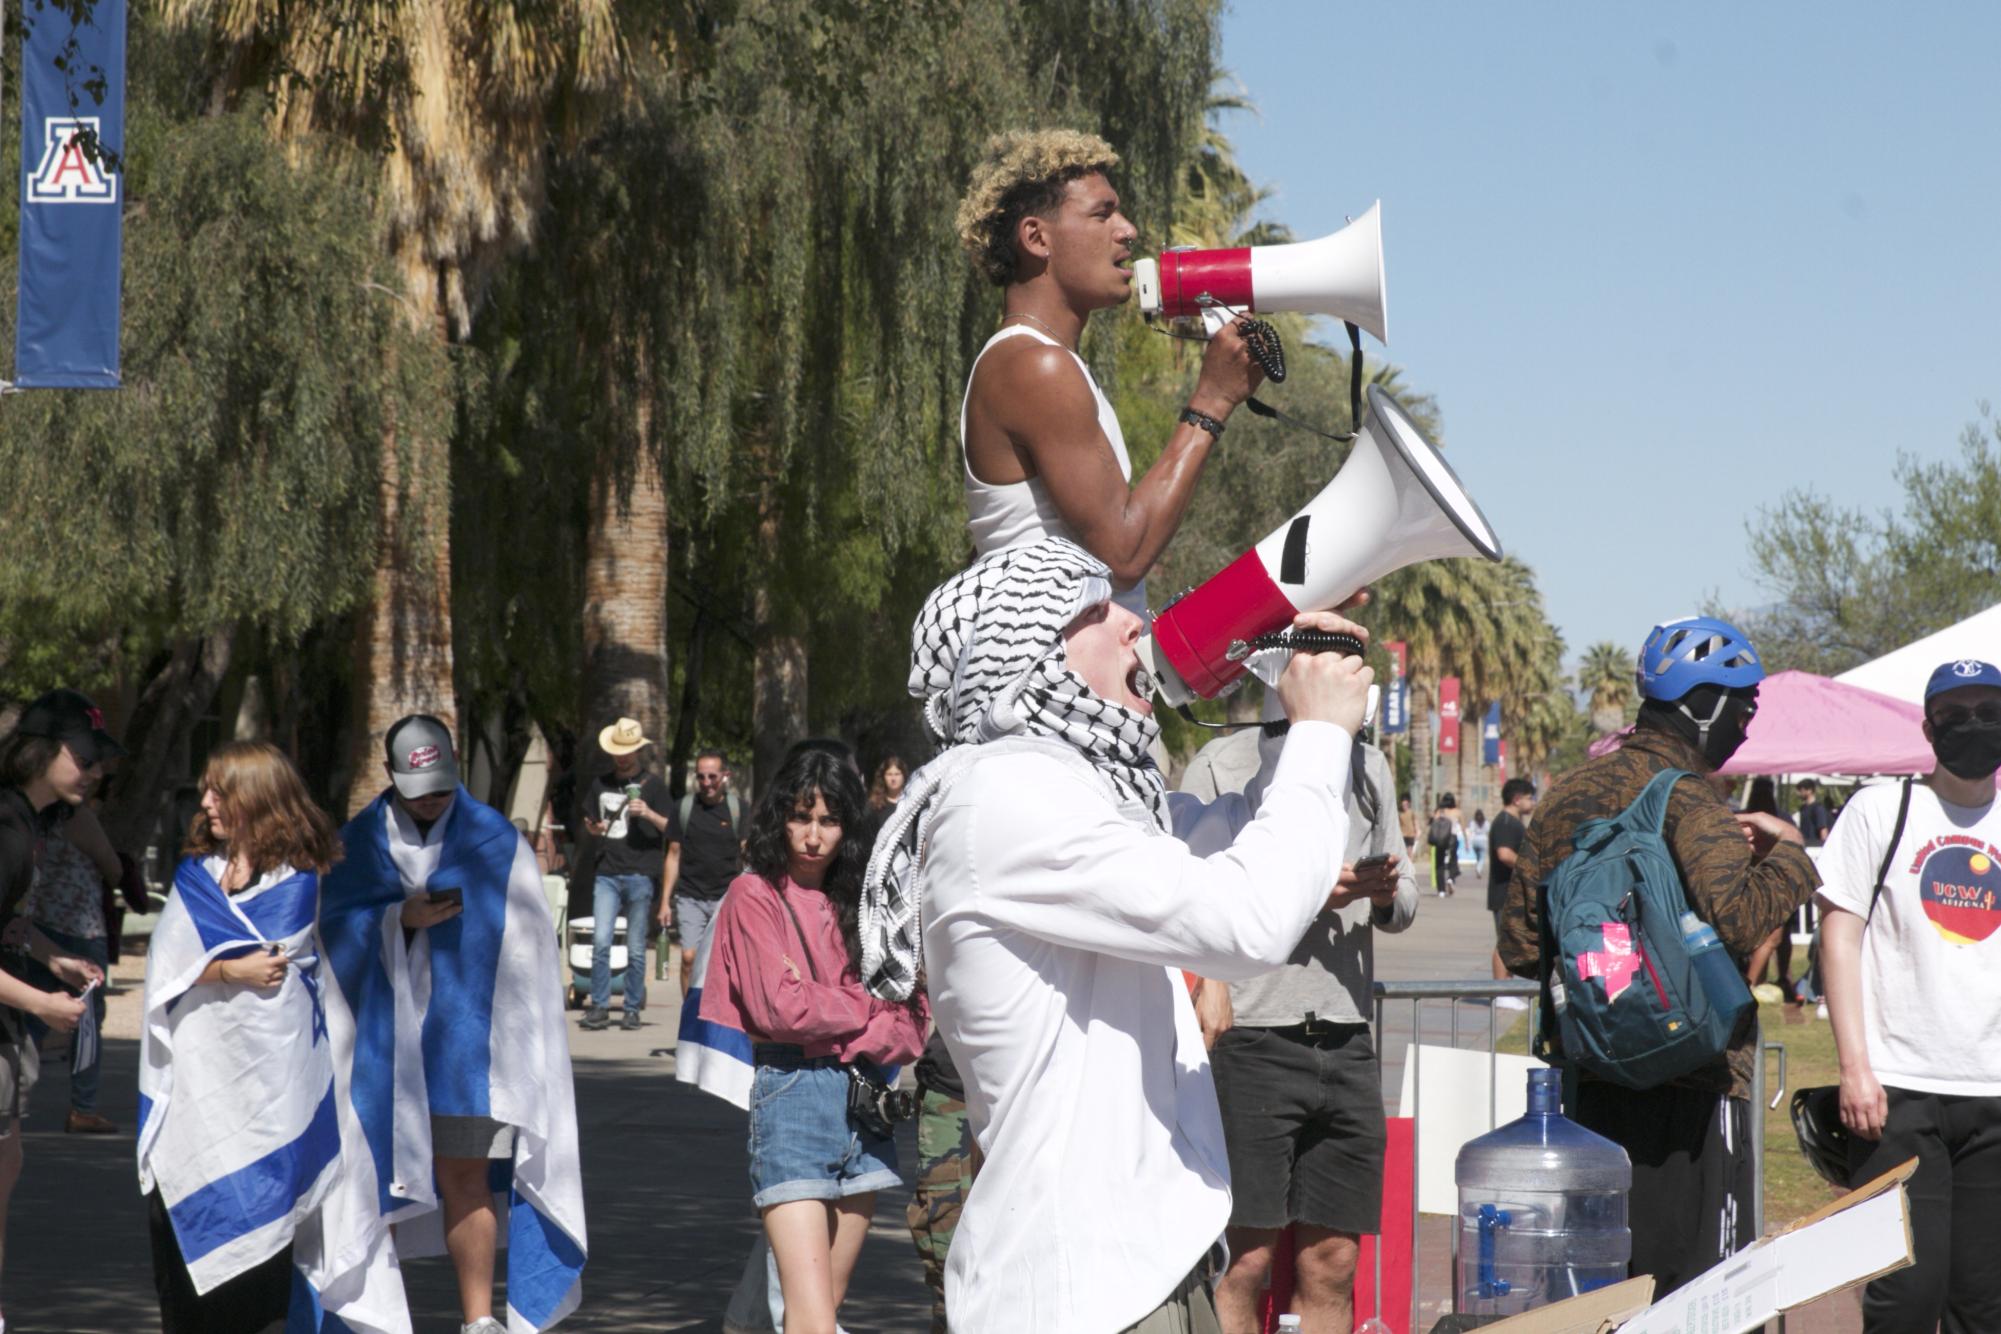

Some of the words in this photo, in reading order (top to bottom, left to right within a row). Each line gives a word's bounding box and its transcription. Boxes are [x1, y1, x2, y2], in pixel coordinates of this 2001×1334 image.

[27, 117, 116, 203] A
[1932, 881, 1982, 900] UCW
[1942, 898, 1984, 909] ARIZONA
